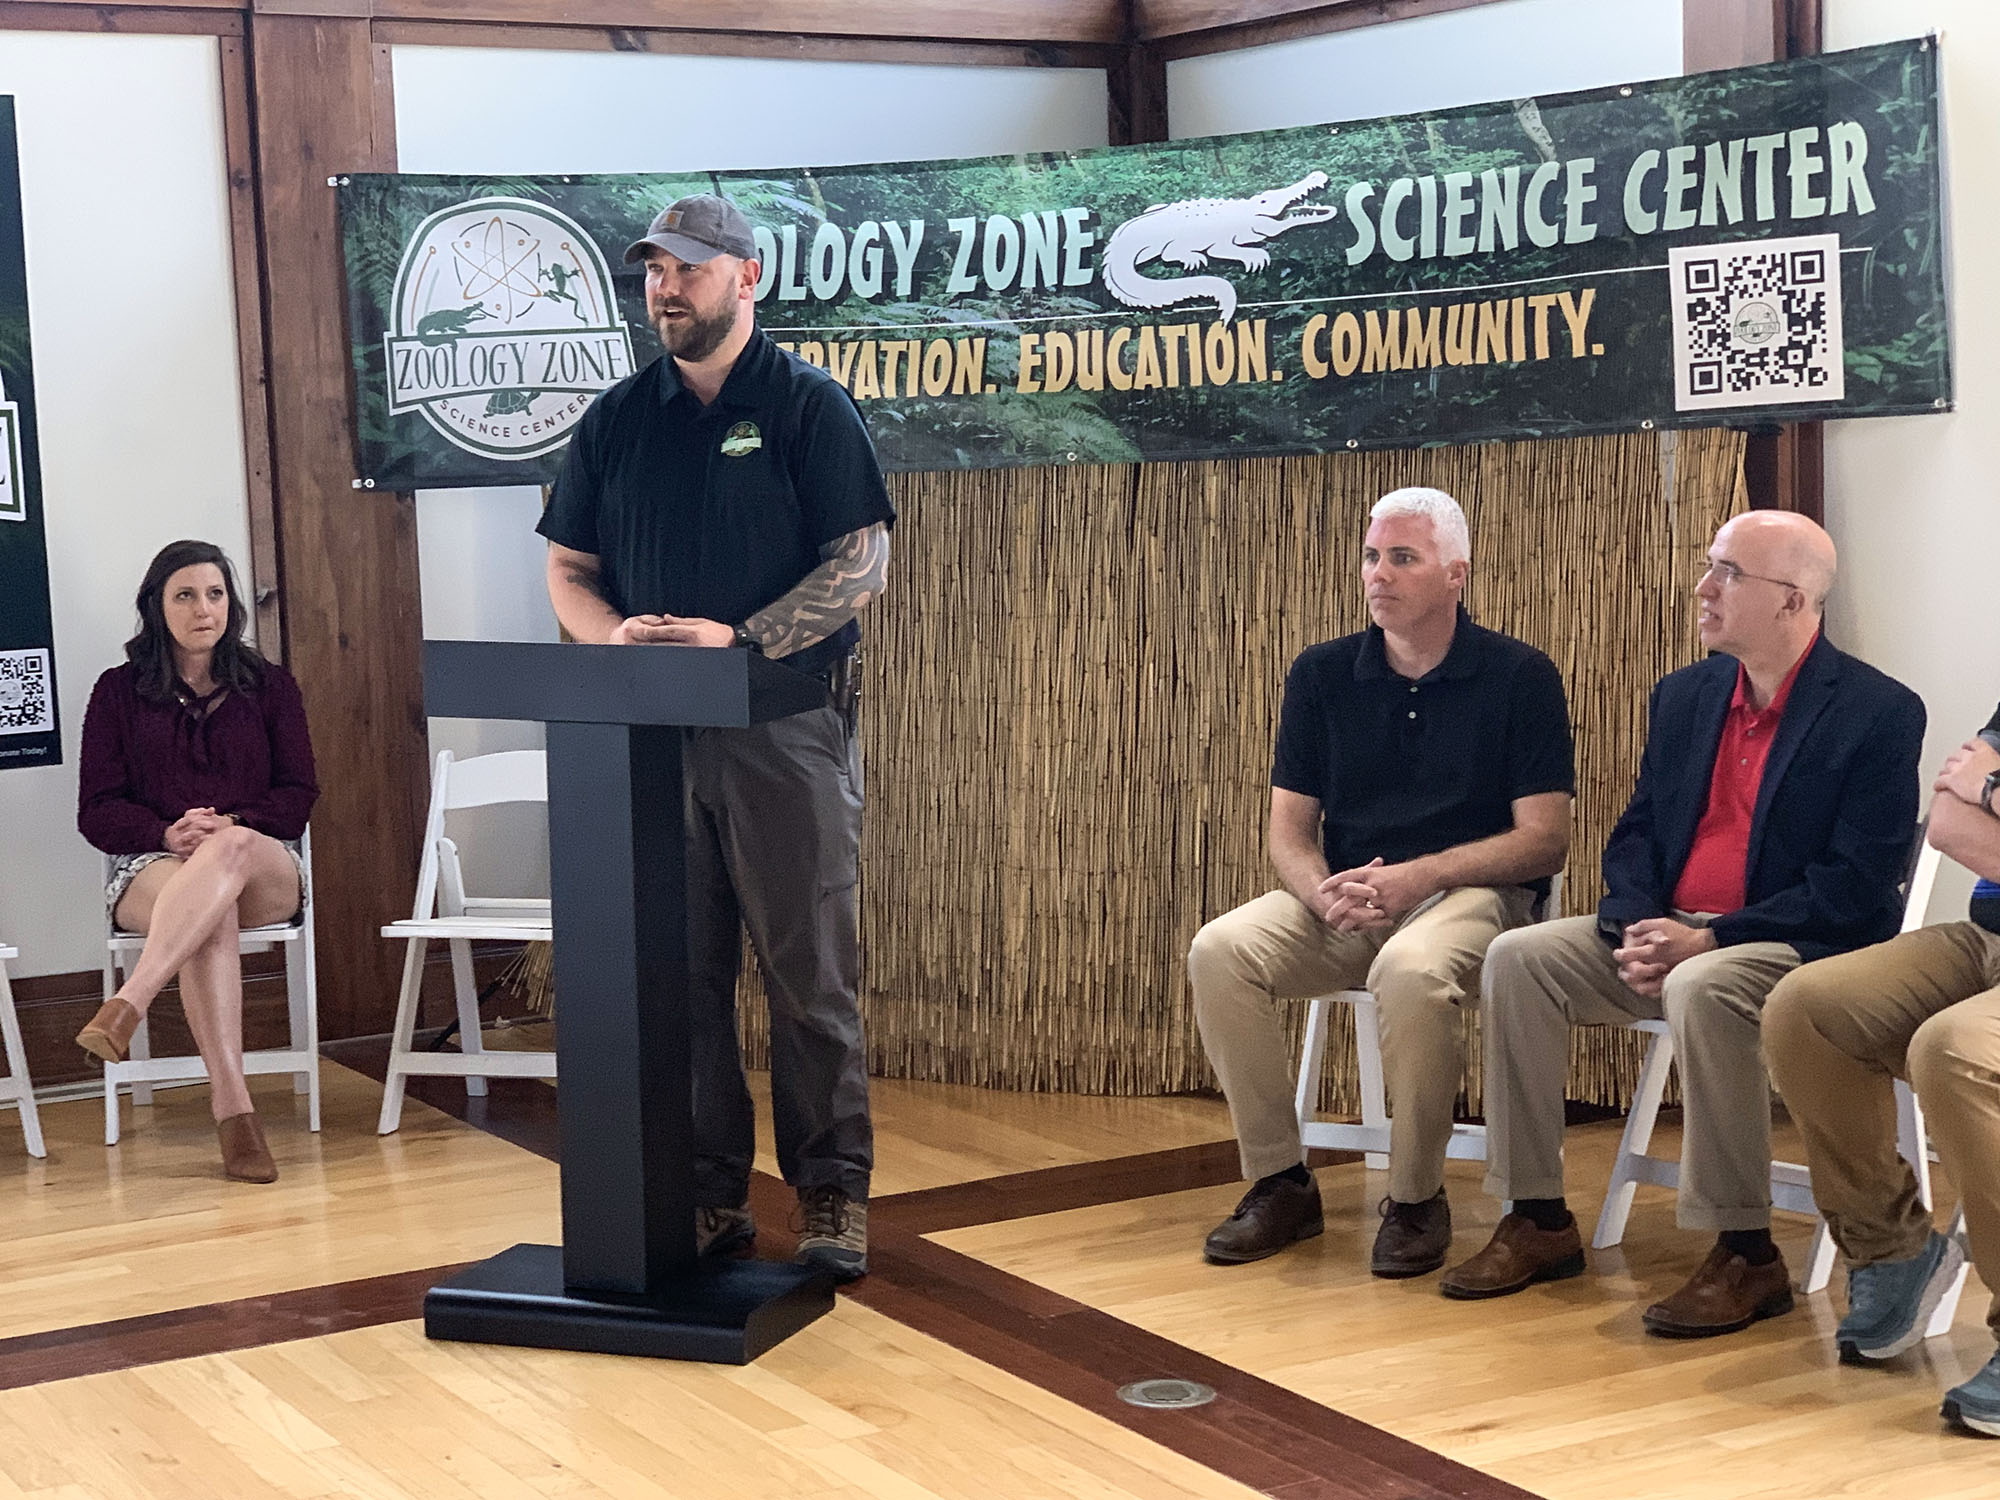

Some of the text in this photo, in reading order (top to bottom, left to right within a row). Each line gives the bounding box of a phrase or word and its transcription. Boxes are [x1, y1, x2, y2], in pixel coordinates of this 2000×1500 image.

[752, 121, 1876, 303] OLOGY ZONE SCIENCE CENTER
[396, 338, 628, 390] ZOOLOGY ZONE
[776, 288, 1605, 401] VATION. EDUCATION. COMMUNITY.
[439, 394, 589, 438] SCIENCE CENTER
